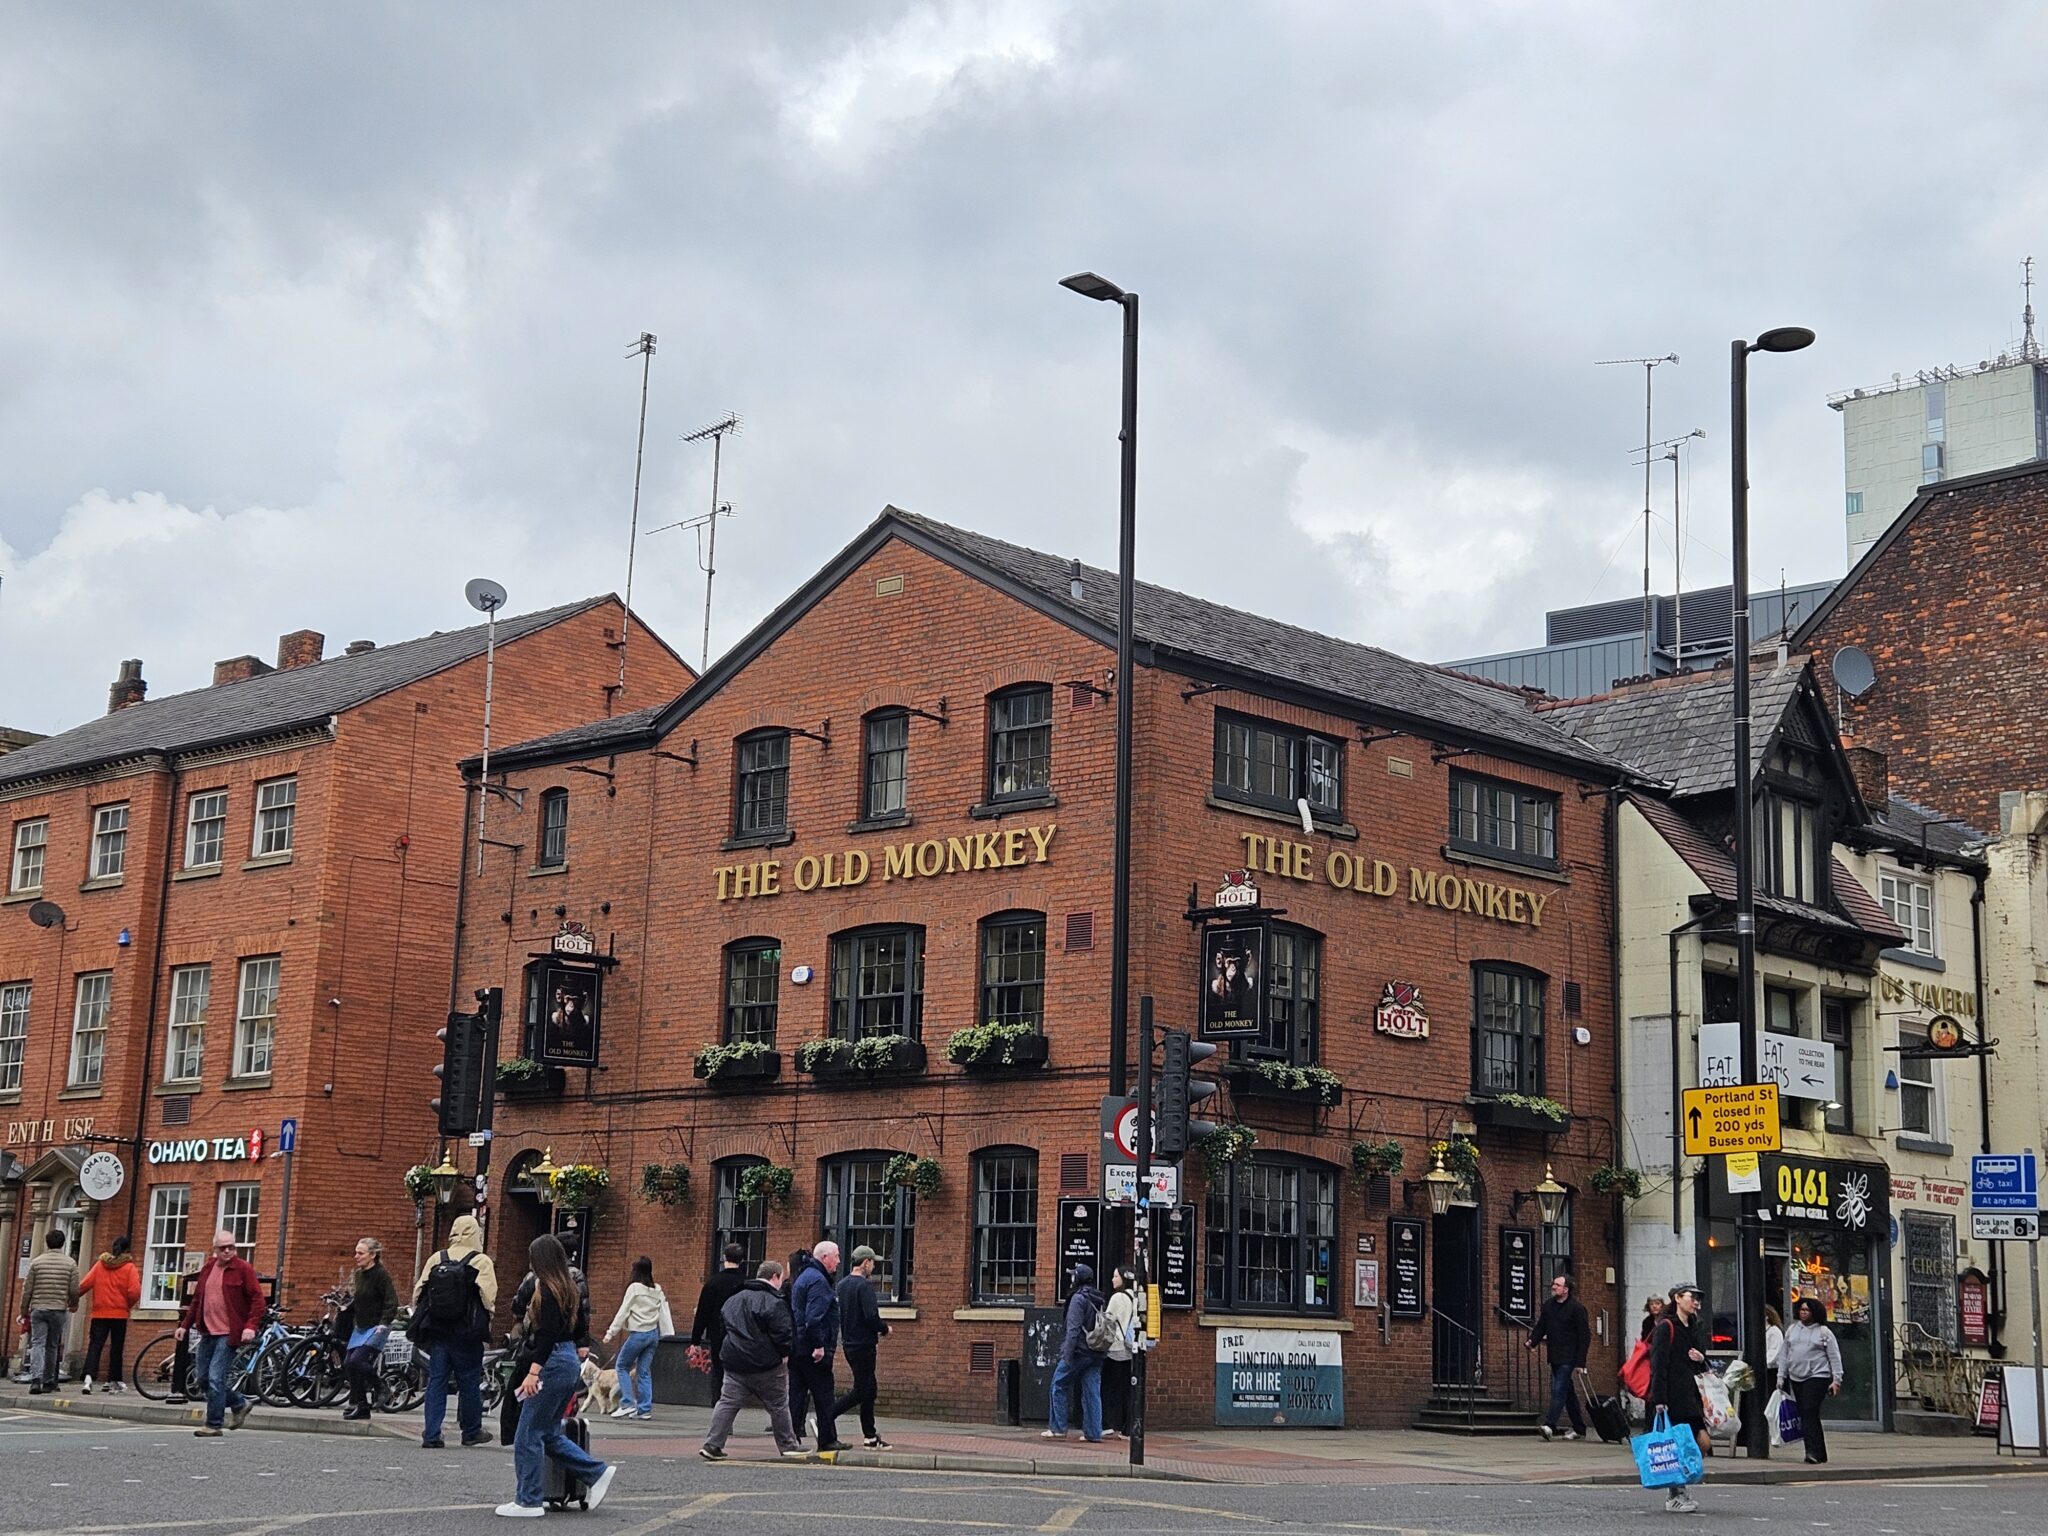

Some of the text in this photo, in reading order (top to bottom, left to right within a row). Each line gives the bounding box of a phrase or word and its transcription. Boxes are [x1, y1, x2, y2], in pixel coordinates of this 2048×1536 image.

[713, 824, 1057, 900] THE OLD MONKEY
[1240, 832, 1547, 926] THE OLD MONKEY
[1218, 891, 1256, 904] HOLT
[556, 939, 591, 952] HOLT
[1909, 980, 1976, 1018] TAVERN
[1391, 1007, 1415, 1016] JOSEPH
[1225, 1019, 1253, 1028] MONKEY
[1379, 1012, 1426, 1033] HOLT
[563, 1049, 589, 1057] MONKEY
[1764, 1039, 1784, 1064] FAT
[1798, 1048, 1824, 1058] COLLECTION
[1707, 1056, 1733, 1075] FAT
[1814, 1060, 1824, 1068] REAR
[1761, 1064, 1789, 1088] PAT'S
[1705, 1089, 1773, 1104] Portland St
[1713, 1105, 1765, 1118] closed in
[1715, 1119, 1764, 1132] 200 yds
[1709, 1133, 1773, 1147] Buses only
[149, 1139, 208, 1164] OHAYO
[212, 1137, 245, 1160] TEA
[84, 1155, 122, 1177] OHAYO TEA
[1110, 1168, 1137, 1178] Excep
[1778, 1164, 1829, 1206] 0161
[1993, 1198, 2007, 1206] any
[1223, 1335, 1244, 1348] FREE
[1233, 1351, 1317, 1371] FUNCTION ROOM
[1232, 1371, 1281, 1391] FOR HIRE
[1294, 1376, 1316, 1392] OLD
[1288, 1393, 1333, 1410] MONKEY
